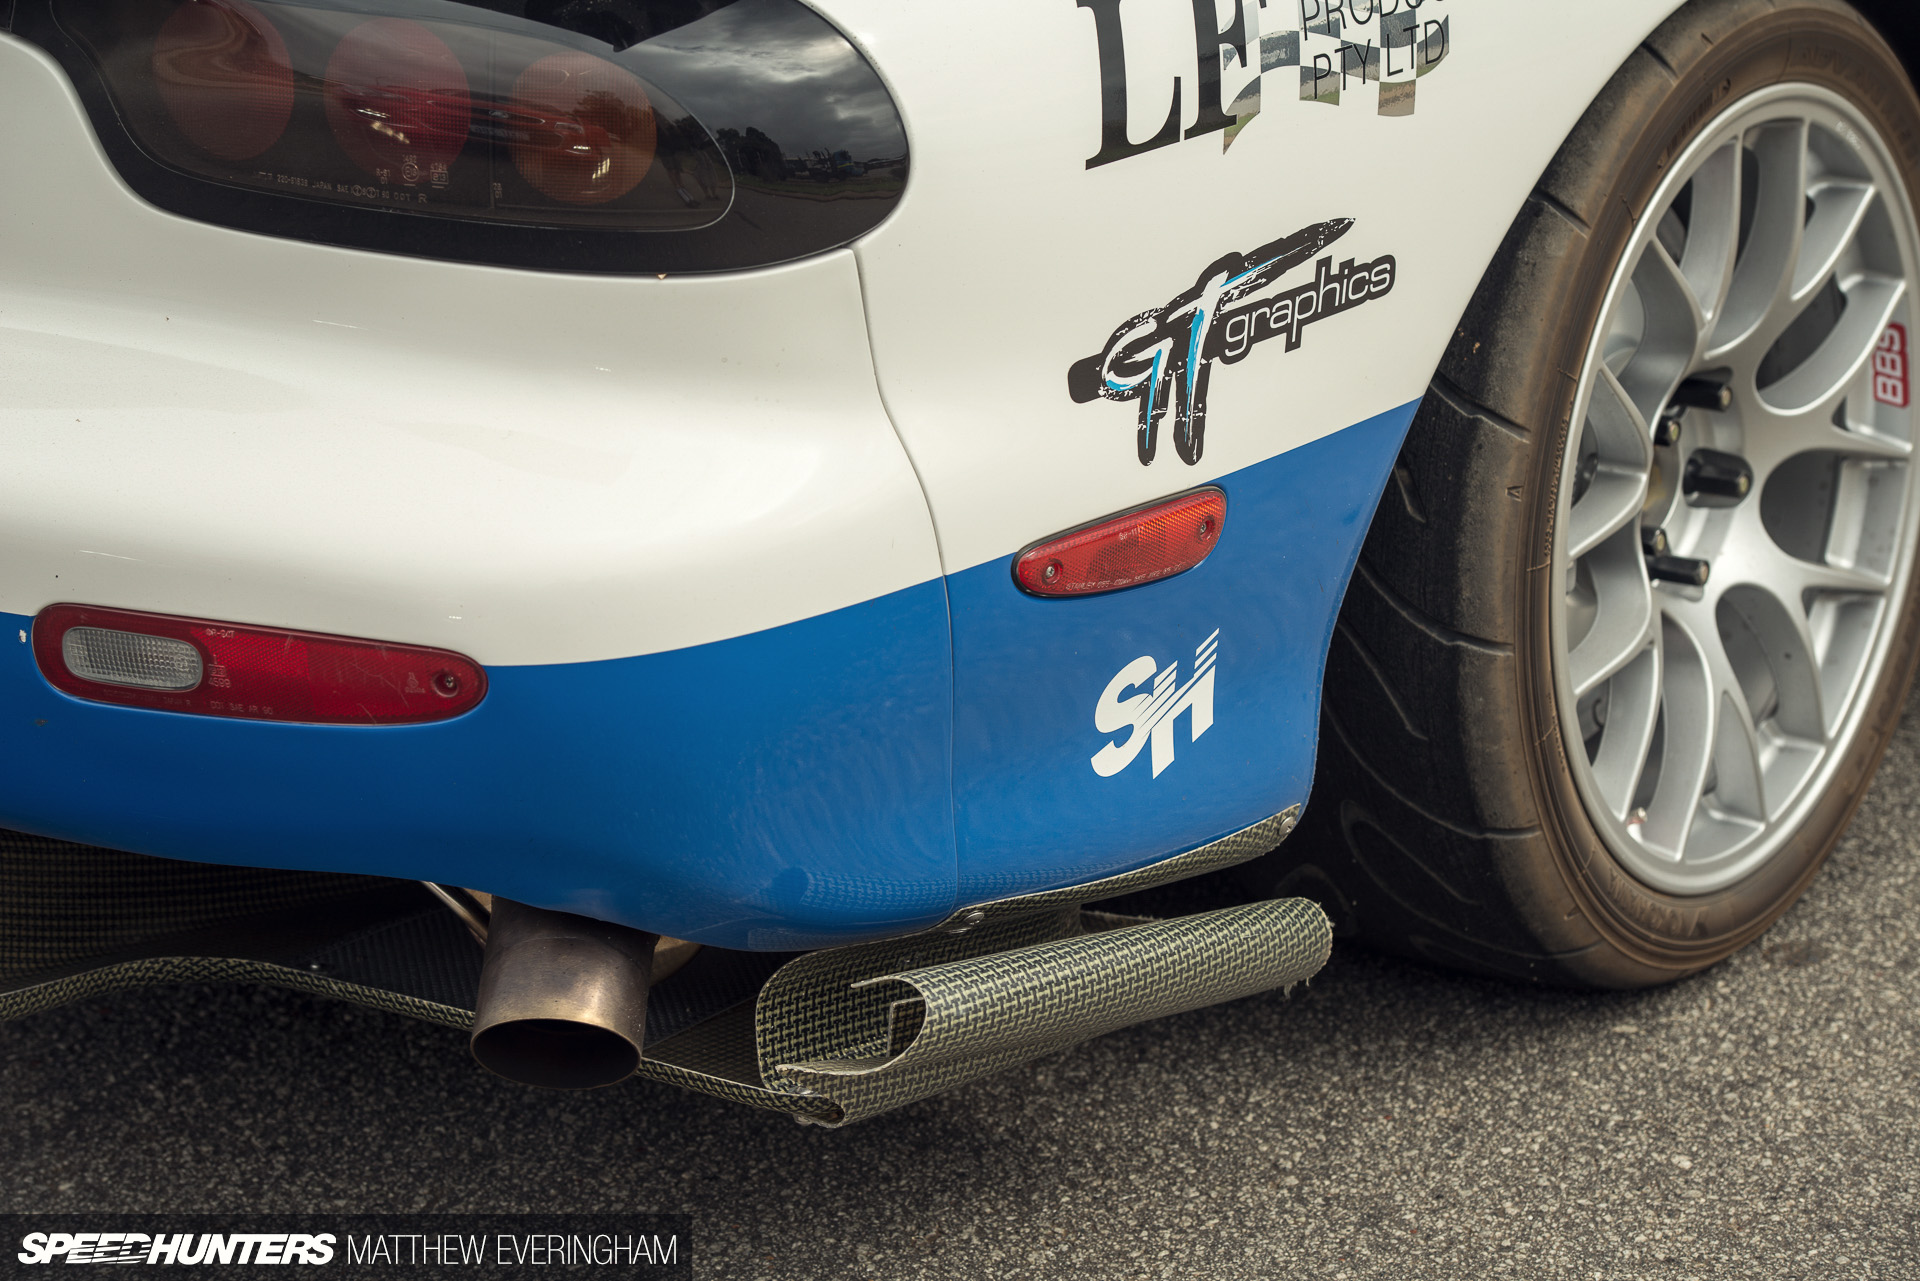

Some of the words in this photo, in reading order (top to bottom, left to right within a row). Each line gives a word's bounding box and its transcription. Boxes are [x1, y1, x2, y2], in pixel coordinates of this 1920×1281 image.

[1313, 39, 1372, 99] PTY
[1386, 19, 1445, 77] LTD
[1224, 263, 1392, 357] graphics
[1874, 324, 1906, 406] BBS
